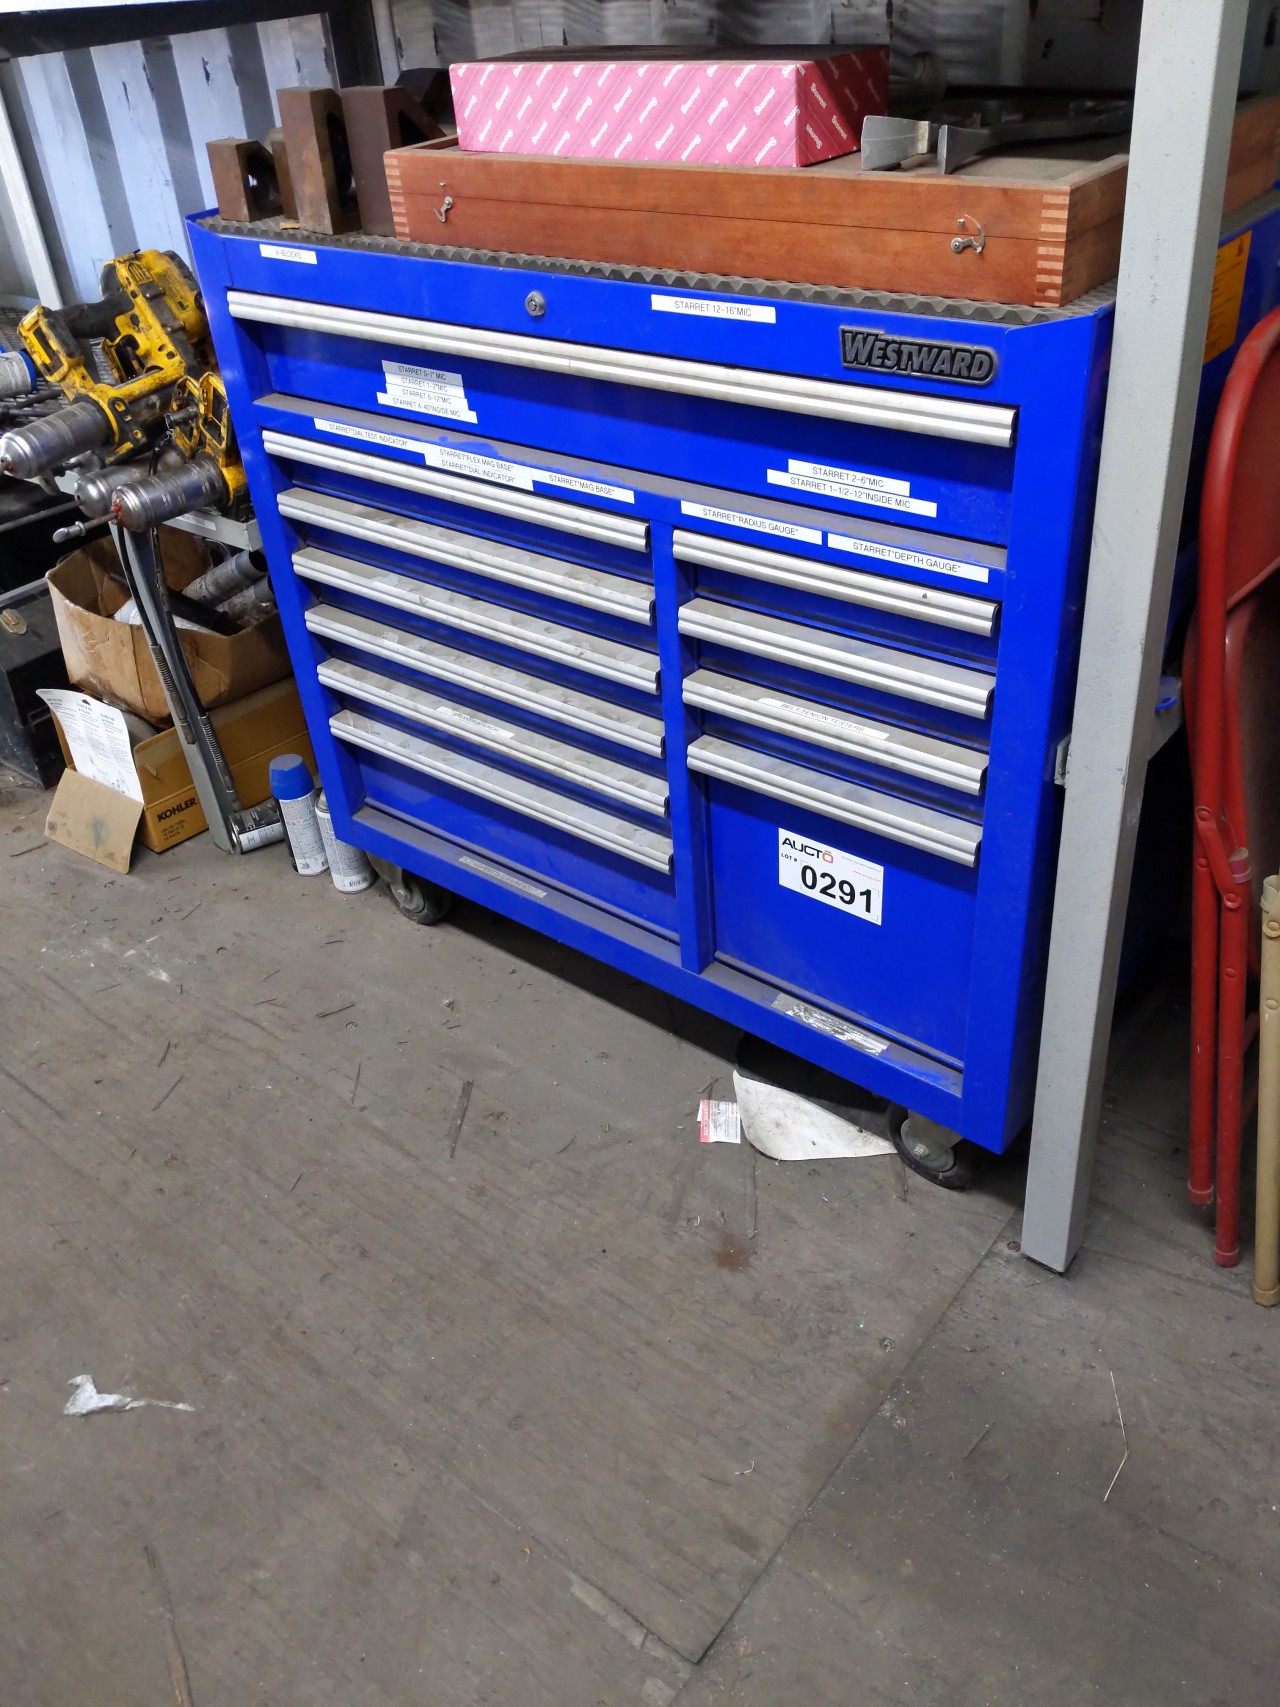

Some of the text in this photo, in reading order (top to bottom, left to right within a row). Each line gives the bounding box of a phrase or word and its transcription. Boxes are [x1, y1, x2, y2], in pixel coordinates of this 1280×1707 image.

[674, 300, 710, 312] STARRET
[843, 332, 990, 378] WESTWARD
[398, 365, 422, 376] STARRET
[400, 376, 426, 388] STARRET
[402, 388, 426, 400] STARRET
[392, 398, 417, 408] STARRET
[364, 431, 378, 440] TEST
[482, 458, 496, 468] MAG
[812, 466, 850, 481] STARRET
[790, 477, 826, 492] STARRET
[894, 498, 911, 509] MIC
[781, 703, 866, 732] BELT TENION TESTERS
[156, 797, 197, 823] KOHLER
[781, 852, 792, 861] LOT
[800, 864, 872, 914] 0291
